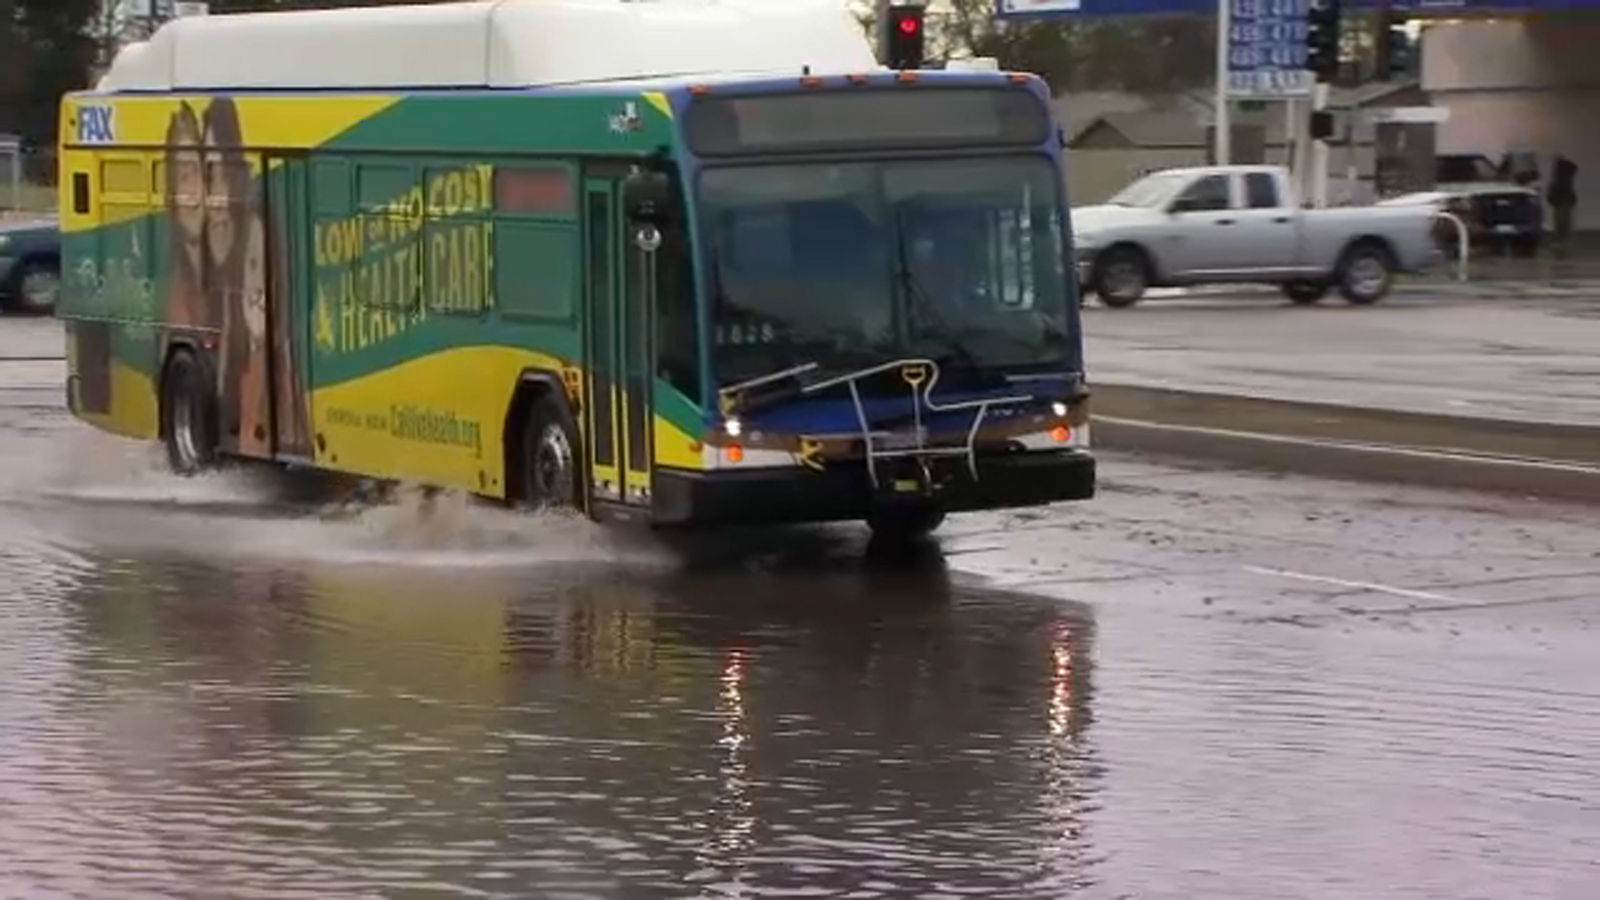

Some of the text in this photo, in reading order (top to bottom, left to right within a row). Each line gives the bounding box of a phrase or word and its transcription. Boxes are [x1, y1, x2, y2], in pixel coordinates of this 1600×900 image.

[78, 106, 114, 141] FAX
[315, 215, 364, 266] LOW
[389, 186, 424, 243] NO
[429, 164, 492, 219] COST
[341, 220, 494, 352] HEALTH CARE
